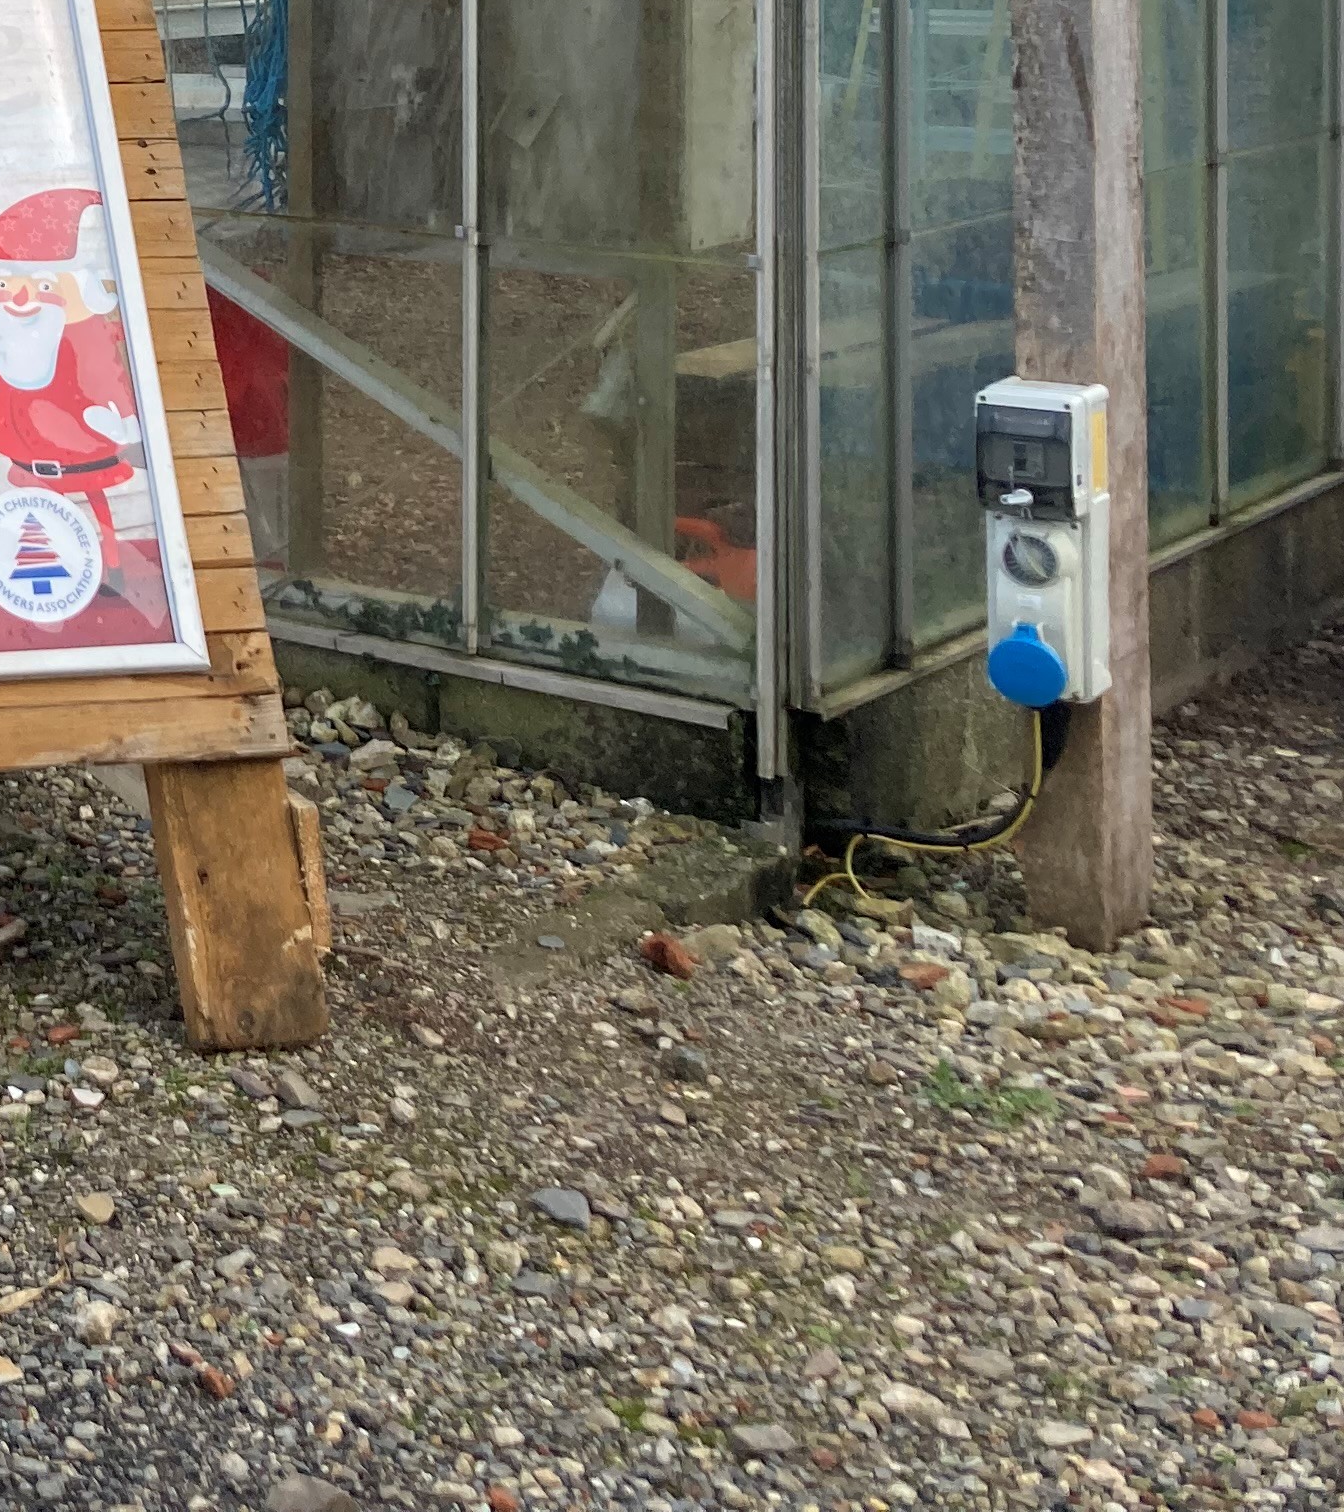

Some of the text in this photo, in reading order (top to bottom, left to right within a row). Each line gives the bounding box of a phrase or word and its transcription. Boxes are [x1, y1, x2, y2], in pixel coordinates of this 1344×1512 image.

[4, 496, 72, 522] CHRISTMAS
[69, 517, 92, 549] TREE
[36, 557, 94, 613] ASSOCIATION
